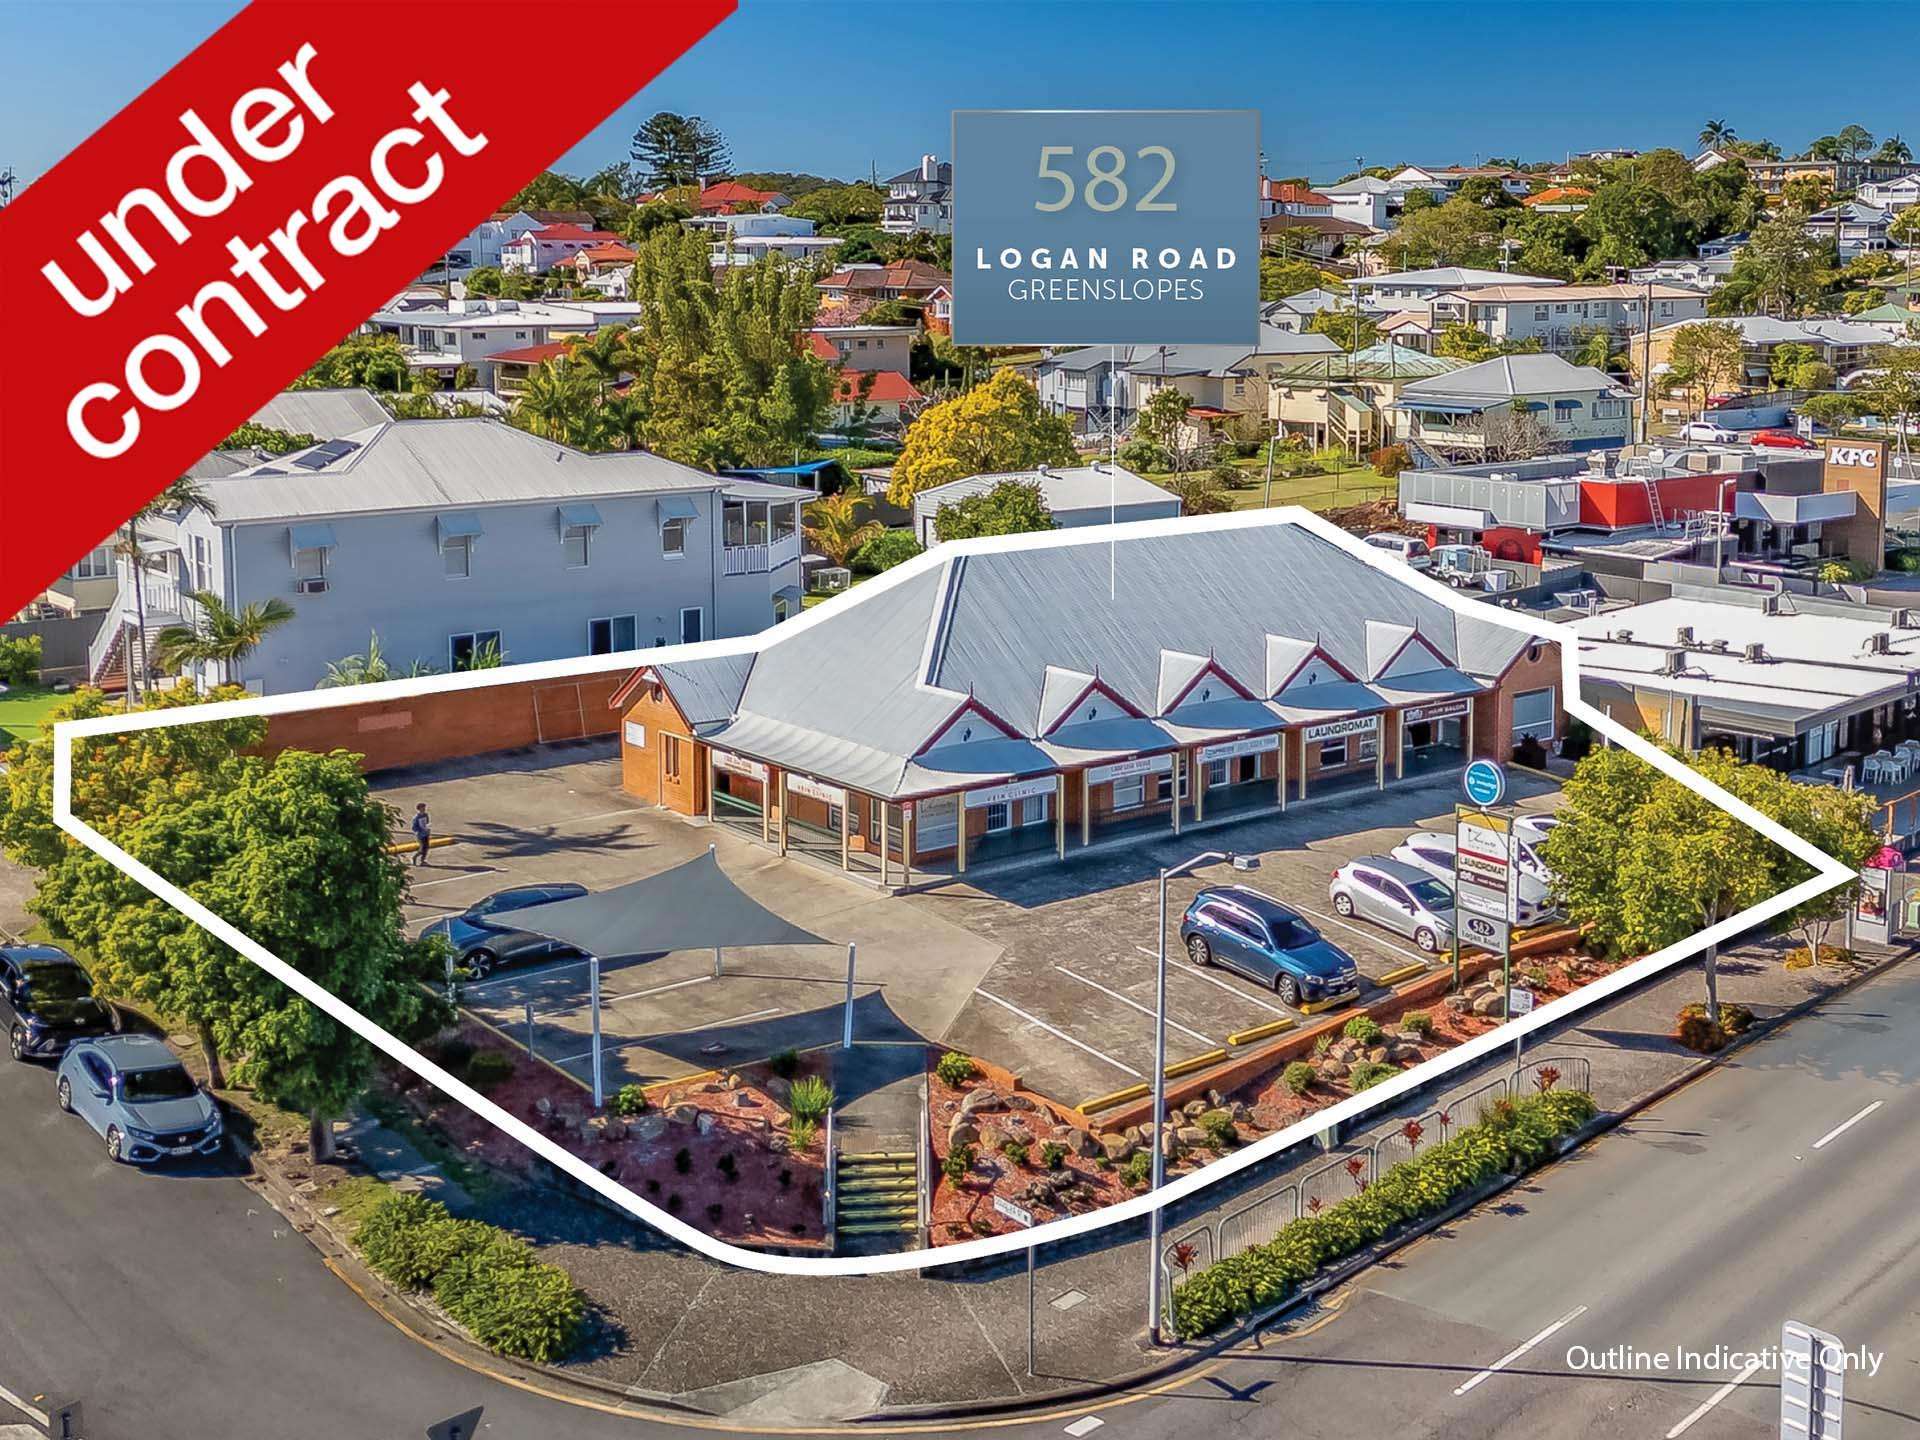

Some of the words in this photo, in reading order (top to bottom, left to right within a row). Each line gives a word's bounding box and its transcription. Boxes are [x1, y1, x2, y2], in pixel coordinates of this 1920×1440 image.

[1828, 447, 1877, 467] KFC
[1307, 717, 1375, 739] LAUNDROMAT
[1007, 786, 1037, 799] CLINIC
[1460, 856, 1505, 876] LAUNDROMAT
[1472, 919, 1491, 936] 582
